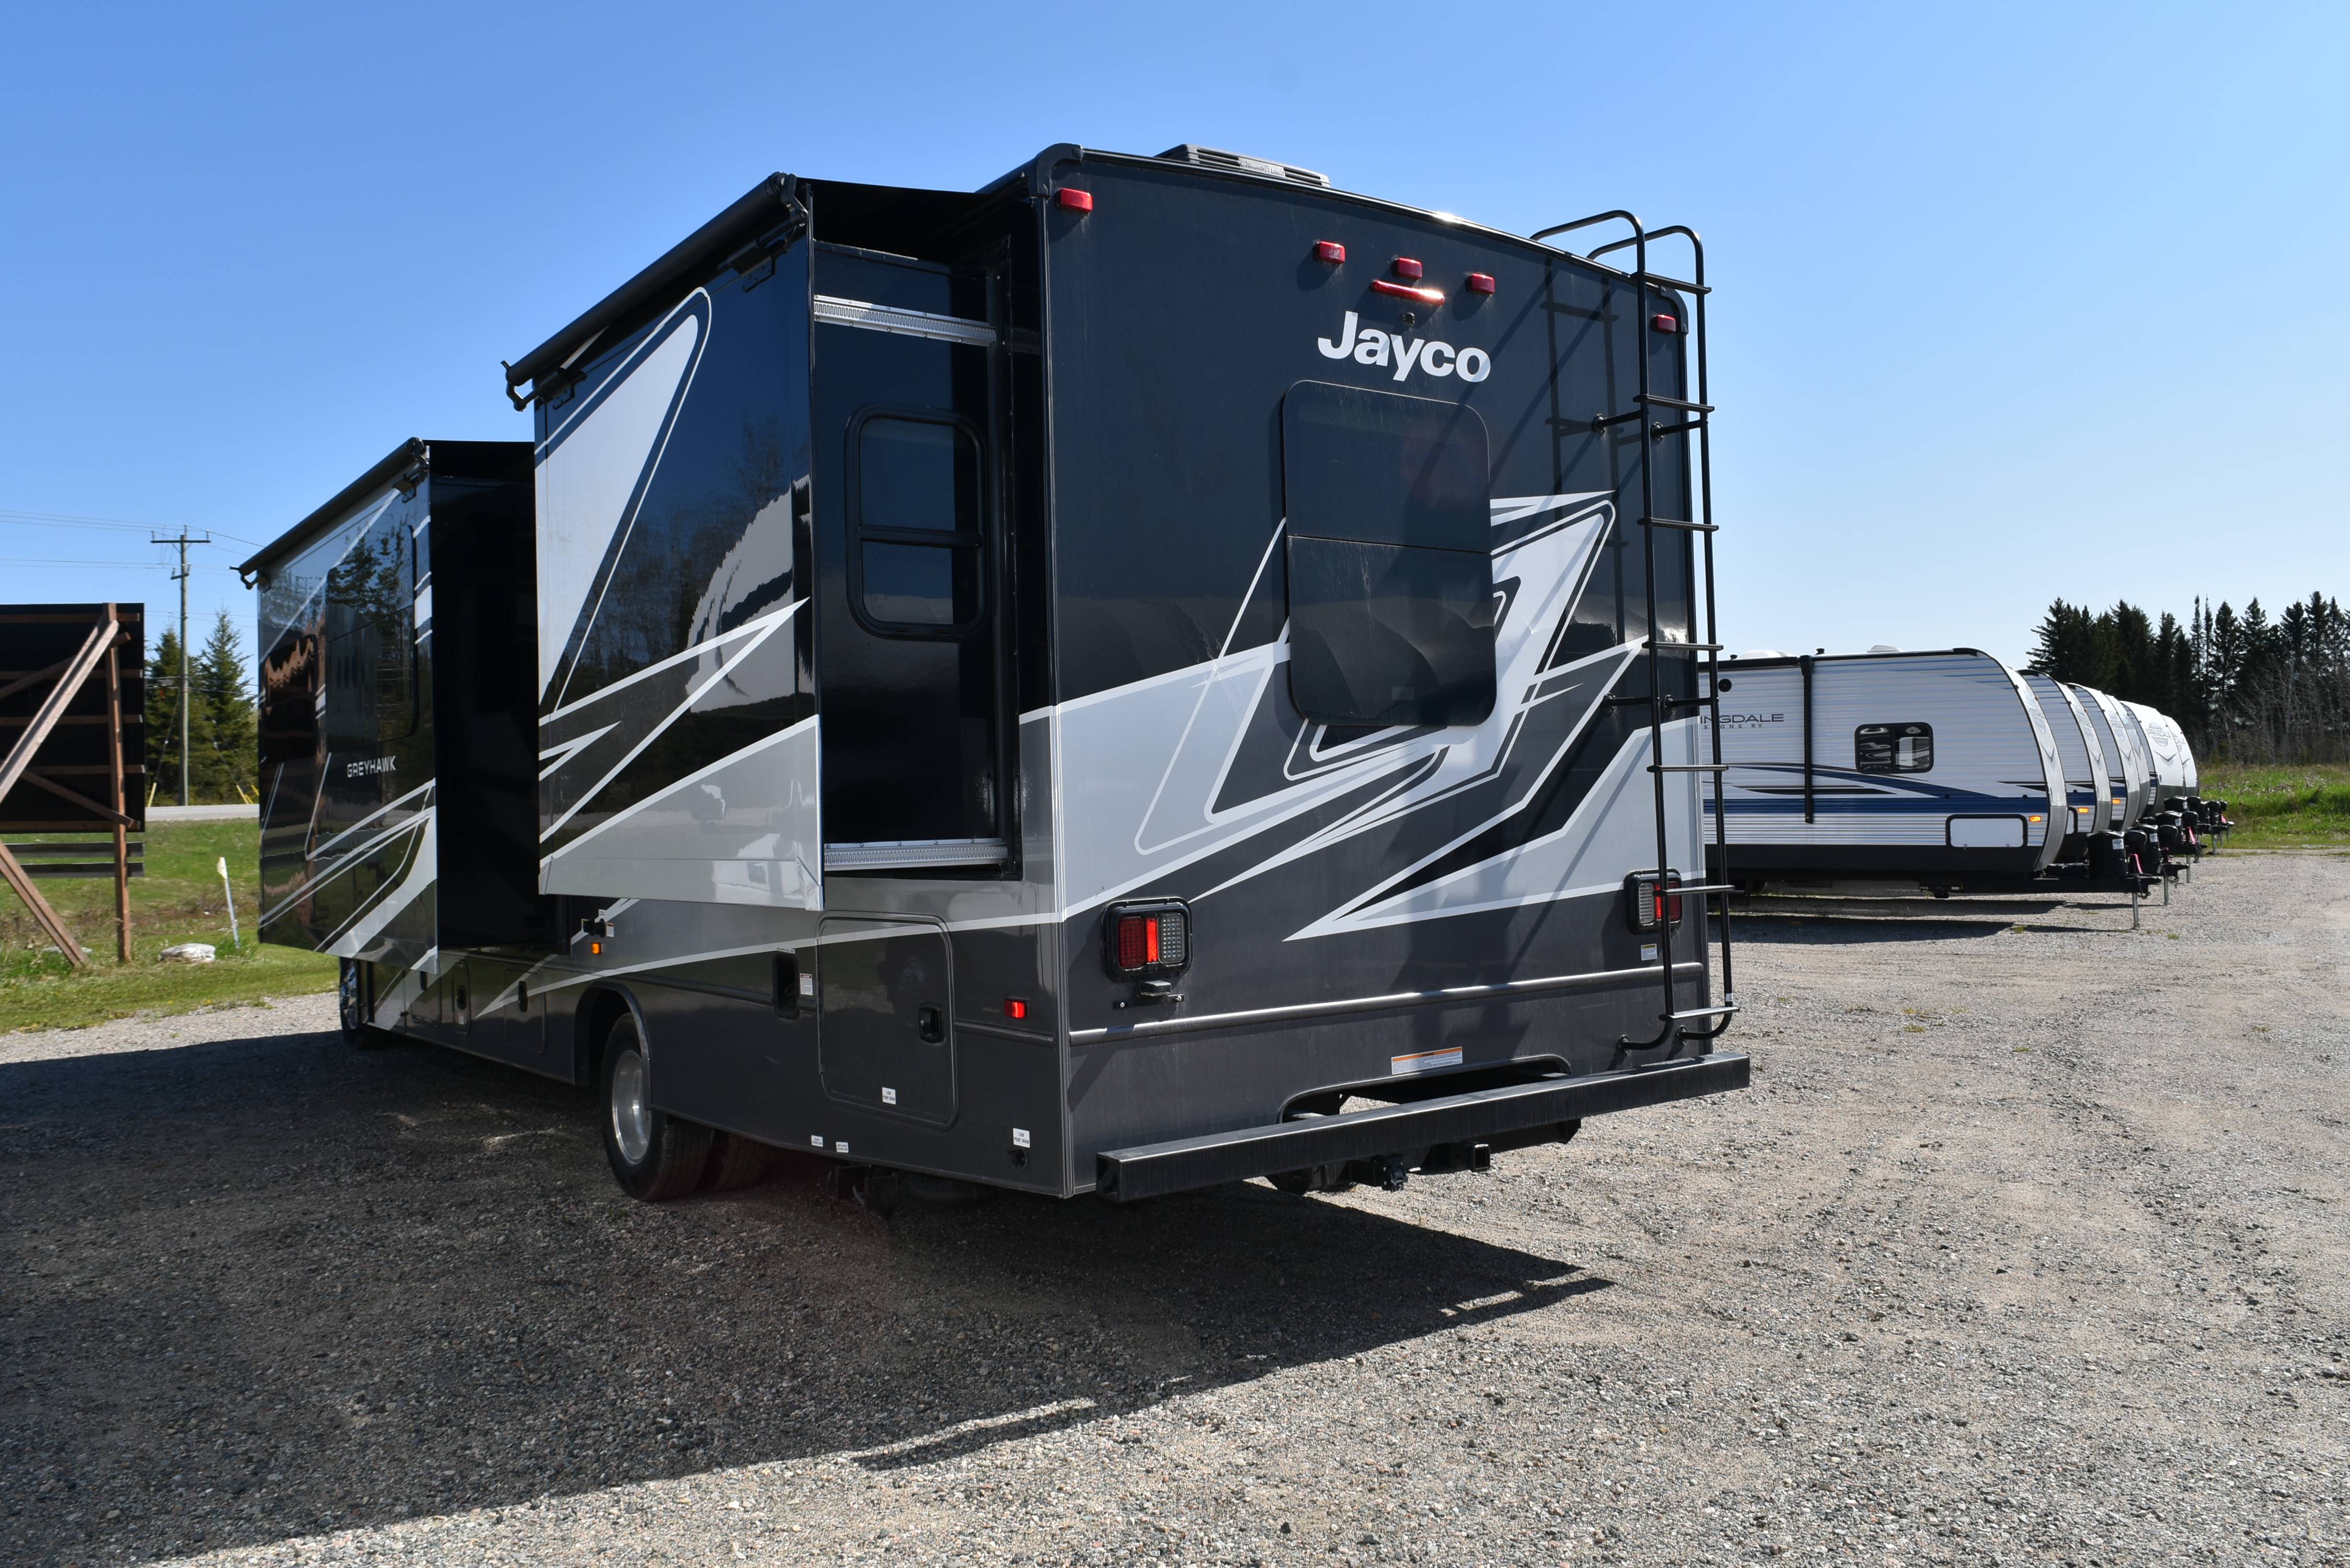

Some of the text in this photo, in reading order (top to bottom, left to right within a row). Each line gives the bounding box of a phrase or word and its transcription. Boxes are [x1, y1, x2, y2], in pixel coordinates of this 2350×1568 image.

[1317, 310, 1491, 383] Jayco
[1700, 713, 1784, 724] INGDALE
[347, 756, 396, 778] GREYHAWK
